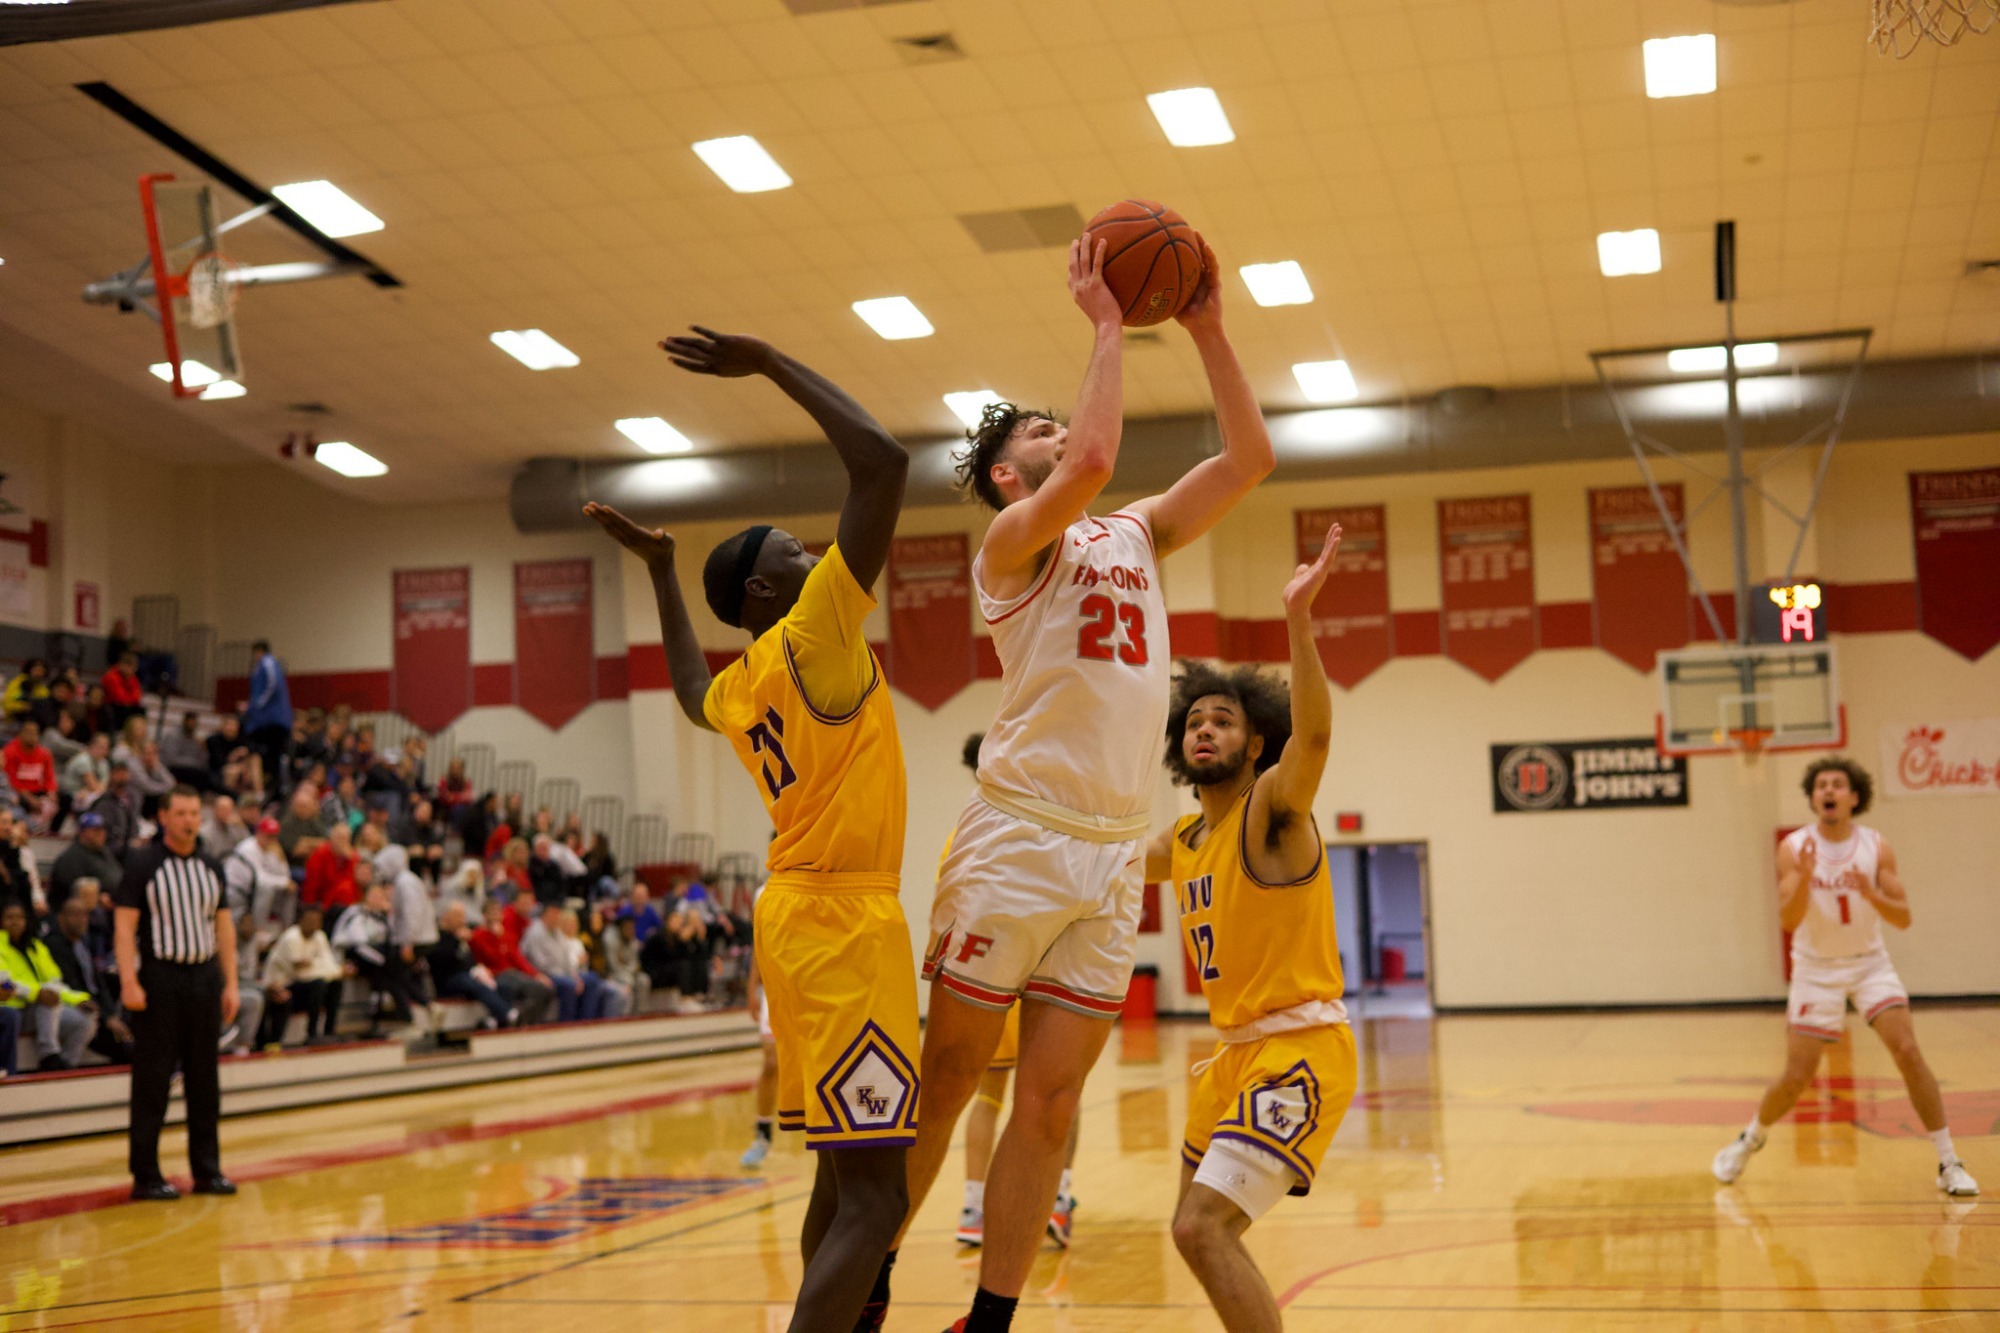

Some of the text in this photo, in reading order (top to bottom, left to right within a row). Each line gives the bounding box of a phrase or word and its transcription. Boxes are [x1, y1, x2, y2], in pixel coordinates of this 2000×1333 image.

[1071, 563, 1149, 592] FALONS
[1077, 592, 1149, 667] 23
[1573, 774, 1682, 806] JOHN'S
[1837, 894, 1850, 925] 1
[955, 931, 995, 964] F
[1189, 923, 1221, 981] 12
[857, 1086, 890, 1117] KW
[1267, 1098, 1292, 1131] KW
